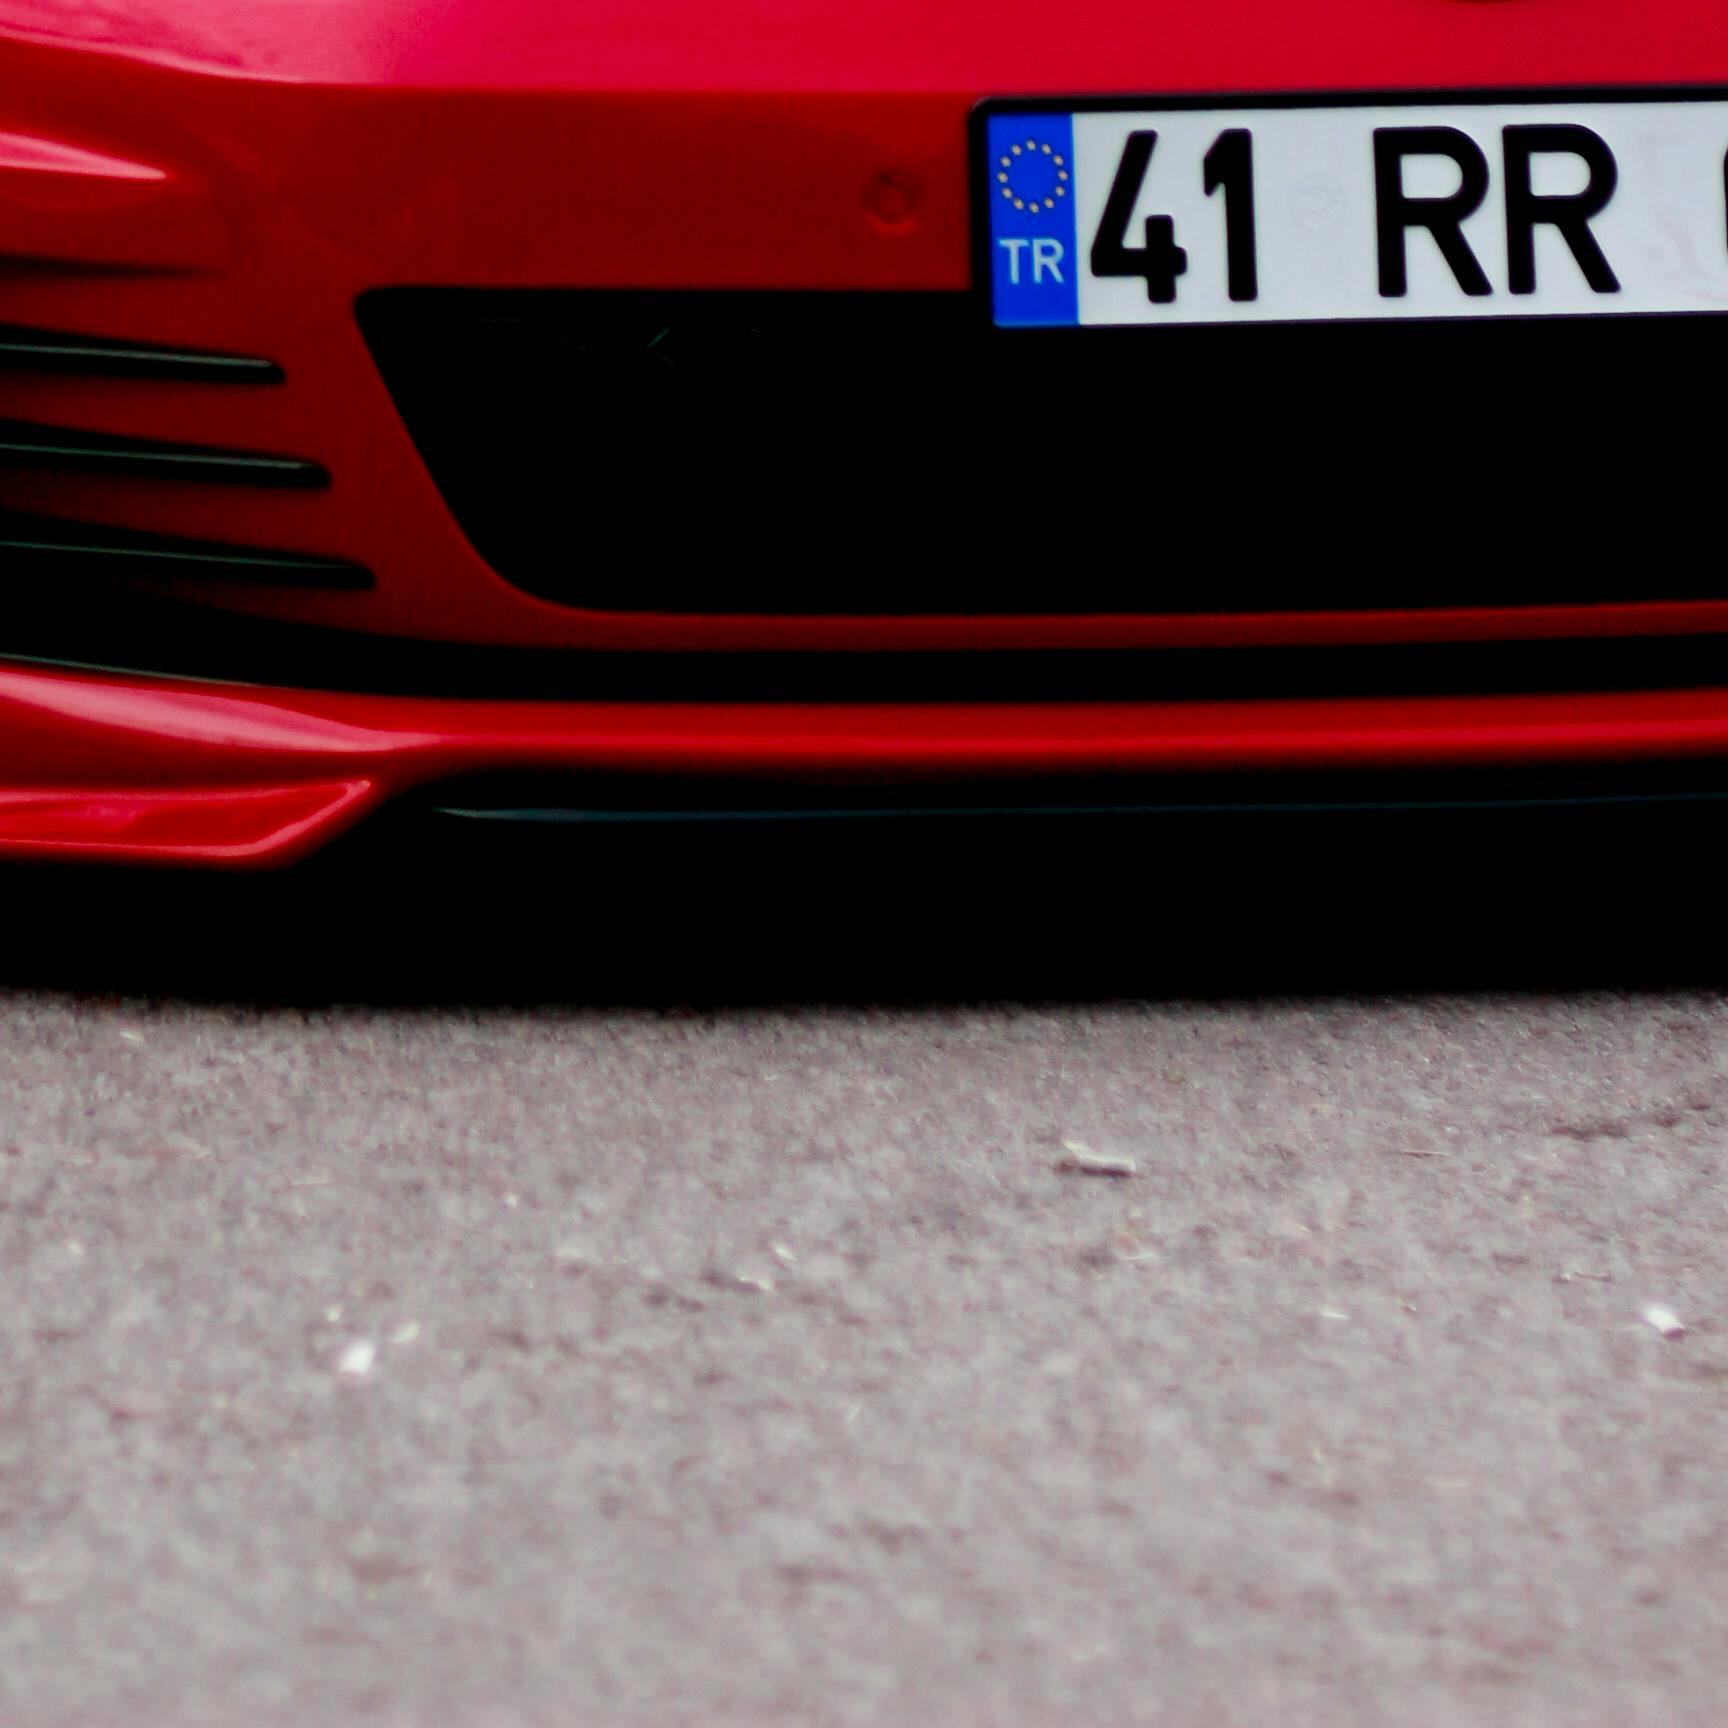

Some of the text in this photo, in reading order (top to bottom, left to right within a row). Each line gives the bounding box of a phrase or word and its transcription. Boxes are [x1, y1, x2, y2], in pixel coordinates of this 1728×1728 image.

[1000, 239, 1064, 284] TR
[1090, 128, 1259, 304] 41
[1373, 124, 1621, 298] RR
